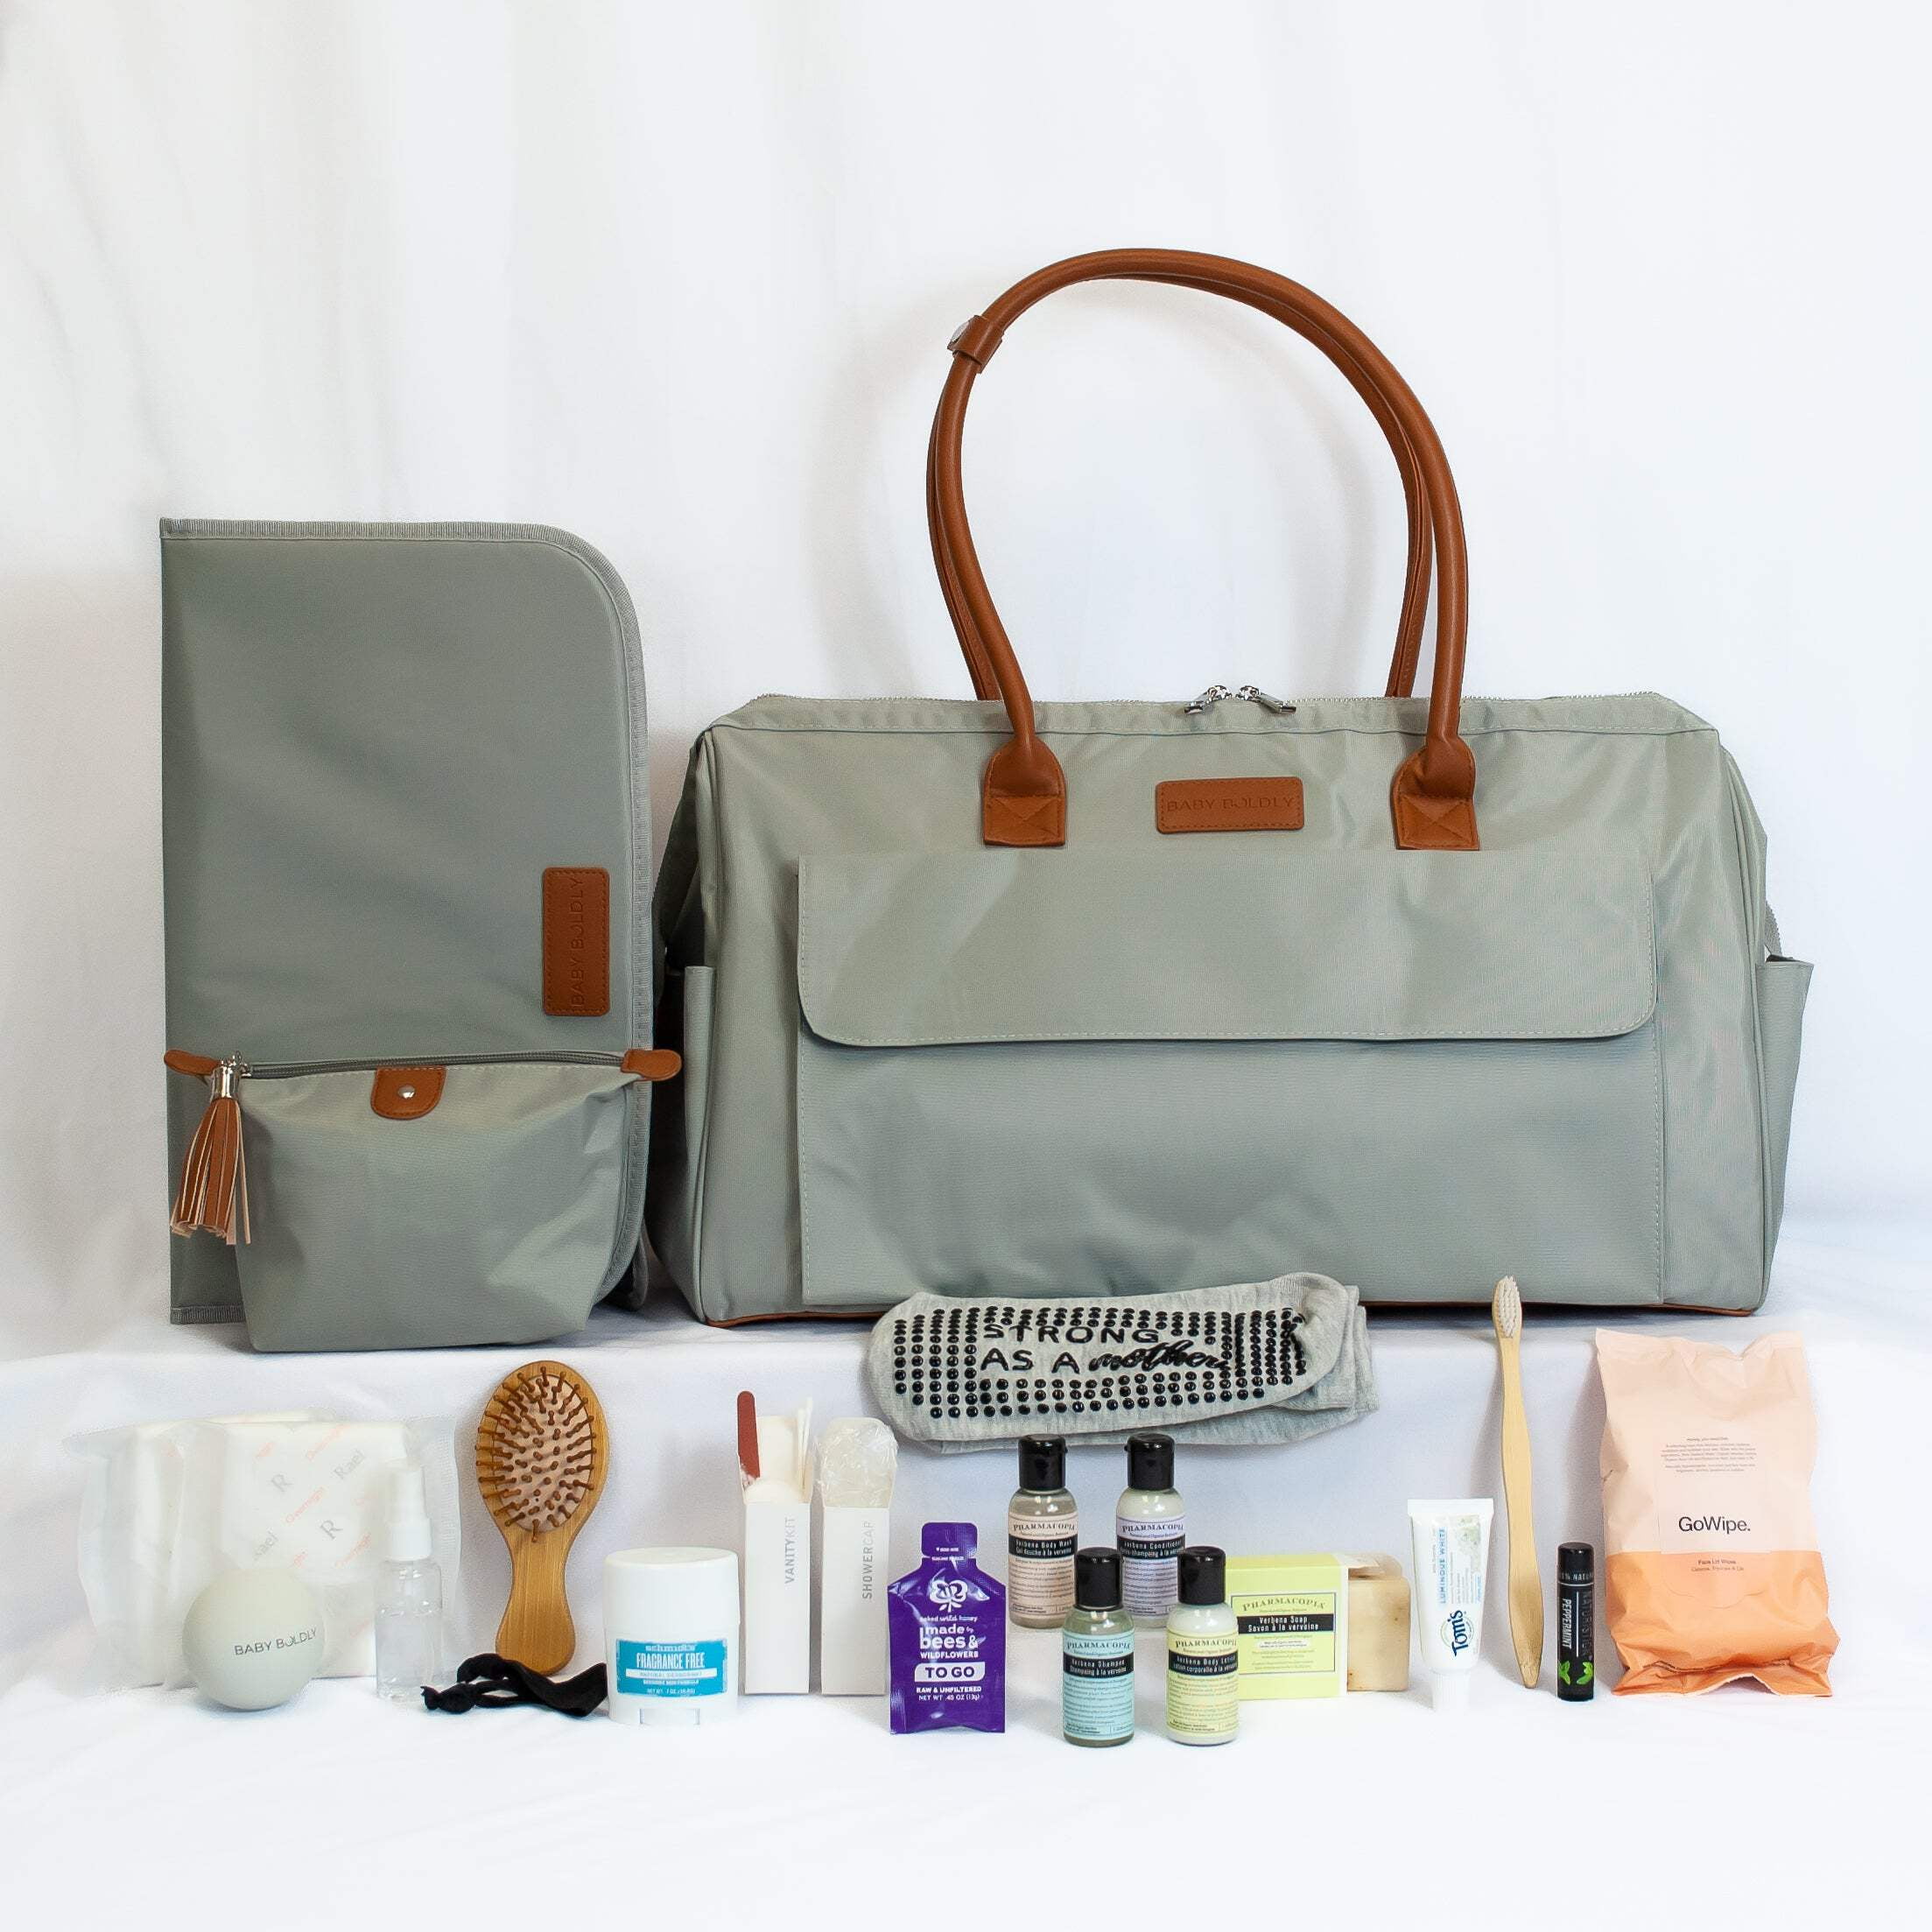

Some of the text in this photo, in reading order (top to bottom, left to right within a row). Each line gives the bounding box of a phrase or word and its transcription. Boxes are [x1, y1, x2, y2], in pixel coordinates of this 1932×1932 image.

[1167, 798, 1215, 812] BABY
[571, 958, 586, 1008] BABY
[982, 1324, 1160, 1344] STRONG
[980, 1347, 1035, 1372] AS
[1050, 1351, 1080, 1374] A
[320, 1519, 344, 1542] R
[1678, 1515, 1751, 1535] GoWipe.
[1242, 1598, 1326, 1612] PHARMACOPIA
[1290, 1615, 1308, 1625] Soap
[1562, 1598, 1572, 1649] PEPPERMINT
[919, 1627, 979, 1649] bees &
[925, 1624, 966, 1635] made
[1447, 1610, 1469, 1657] Tom's
[234, 1640, 272, 1656] BABY
[1067, 1641, 1131, 1650] PHARMACOPIA
[636, 1651, 706, 1669] FRAGRANCE FREE
[920, 1651, 980, 1660] WILDFLOWERS
[924, 1666, 975, 1679] TO GO
